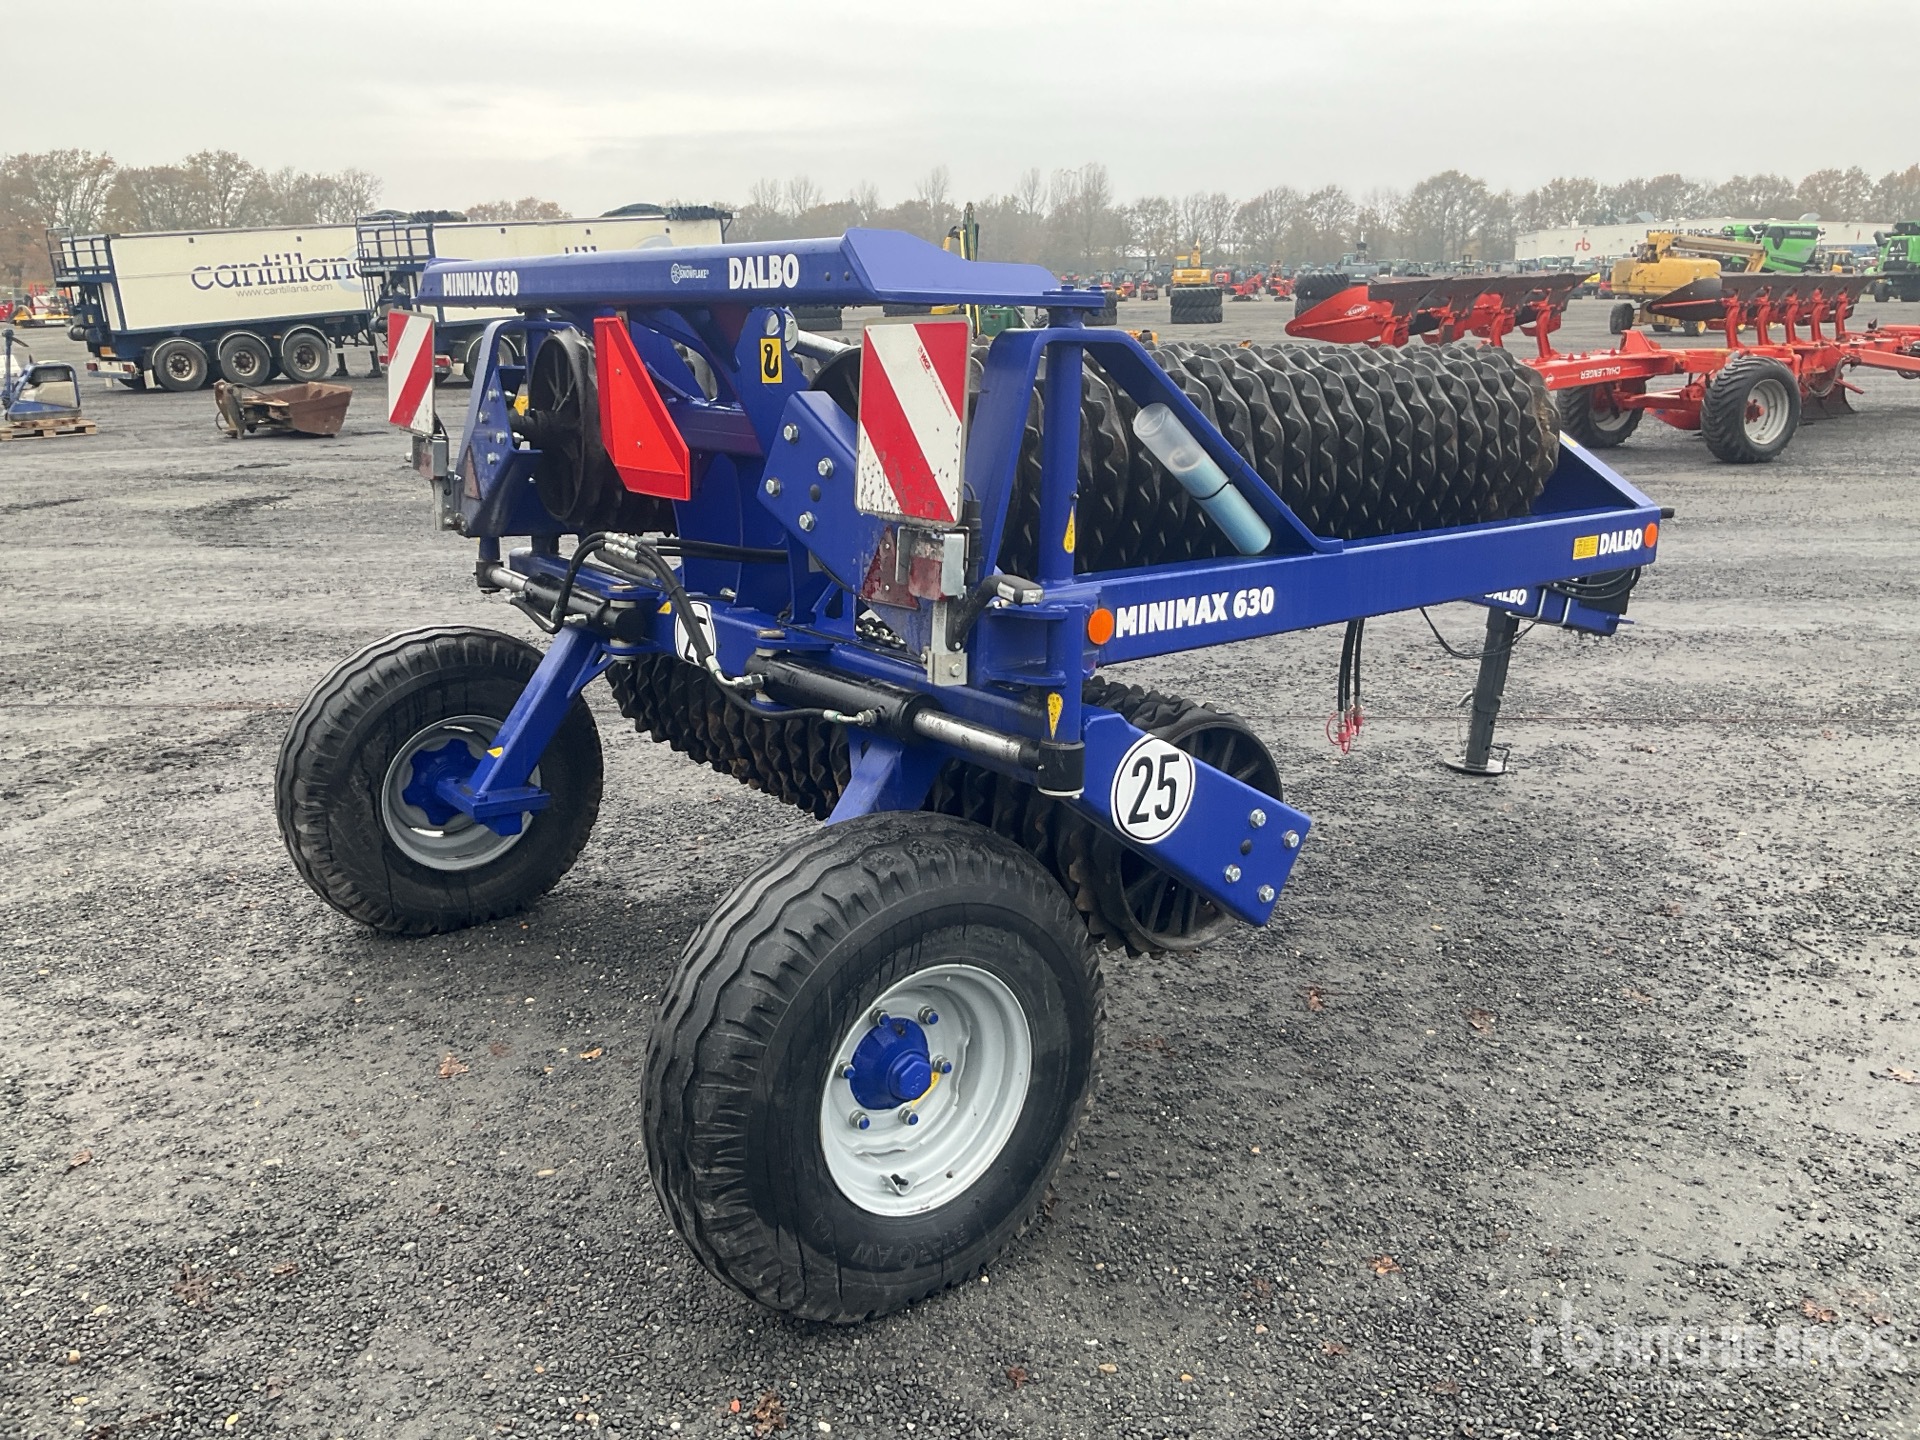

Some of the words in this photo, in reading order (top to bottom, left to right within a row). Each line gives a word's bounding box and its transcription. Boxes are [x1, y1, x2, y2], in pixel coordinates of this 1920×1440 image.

[1575, 237, 1591, 251] rb
[442, 272, 494, 297] MINIMAX
[495, 270, 519, 296] 630
[728, 253, 800, 289] DALBO
[235, 283, 333, 298] www.cantillana.com
[1347, 306, 1367, 316] KUHN
[1598, 528, 1643, 555] DALBO
[1484, 588, 1528, 606] ALBO
[1115, 592, 1229, 638] MINIMAX
[1232, 586, 1275, 619] 630
[1127, 753, 1180, 825] 25
